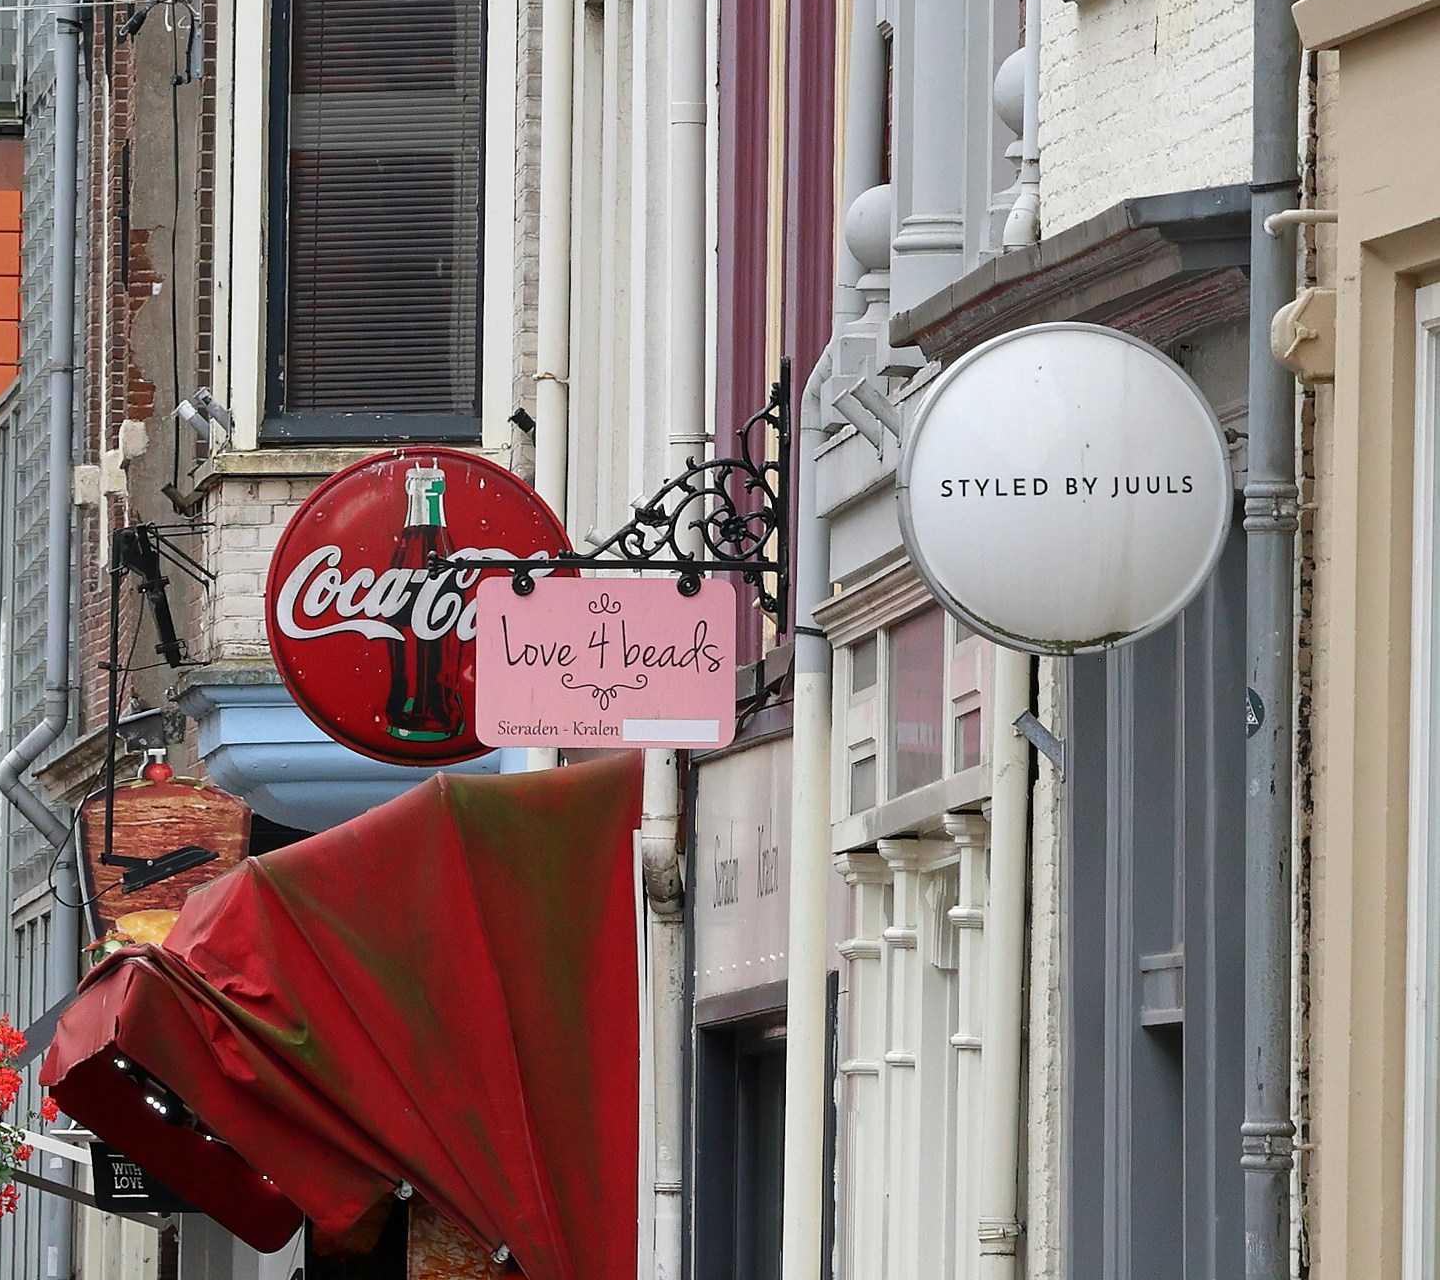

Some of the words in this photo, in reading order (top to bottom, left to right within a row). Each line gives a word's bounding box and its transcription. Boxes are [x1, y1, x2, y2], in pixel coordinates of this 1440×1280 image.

[940, 477, 1049, 498] STYLED
[1065, 476, 1098, 496] BY
[1111, 474, 1194, 498] JUULS
[501, 615, 577, 668] Love
[588, 622, 610, 669] 4
[623, 620, 725, 674] beads
[497, 719, 559, 737] Sieraden
[573, 719, 620, 737] Kralen
[112, 1162, 142, 1175] WITH
[114, 1176, 144, 1189] LOVE
